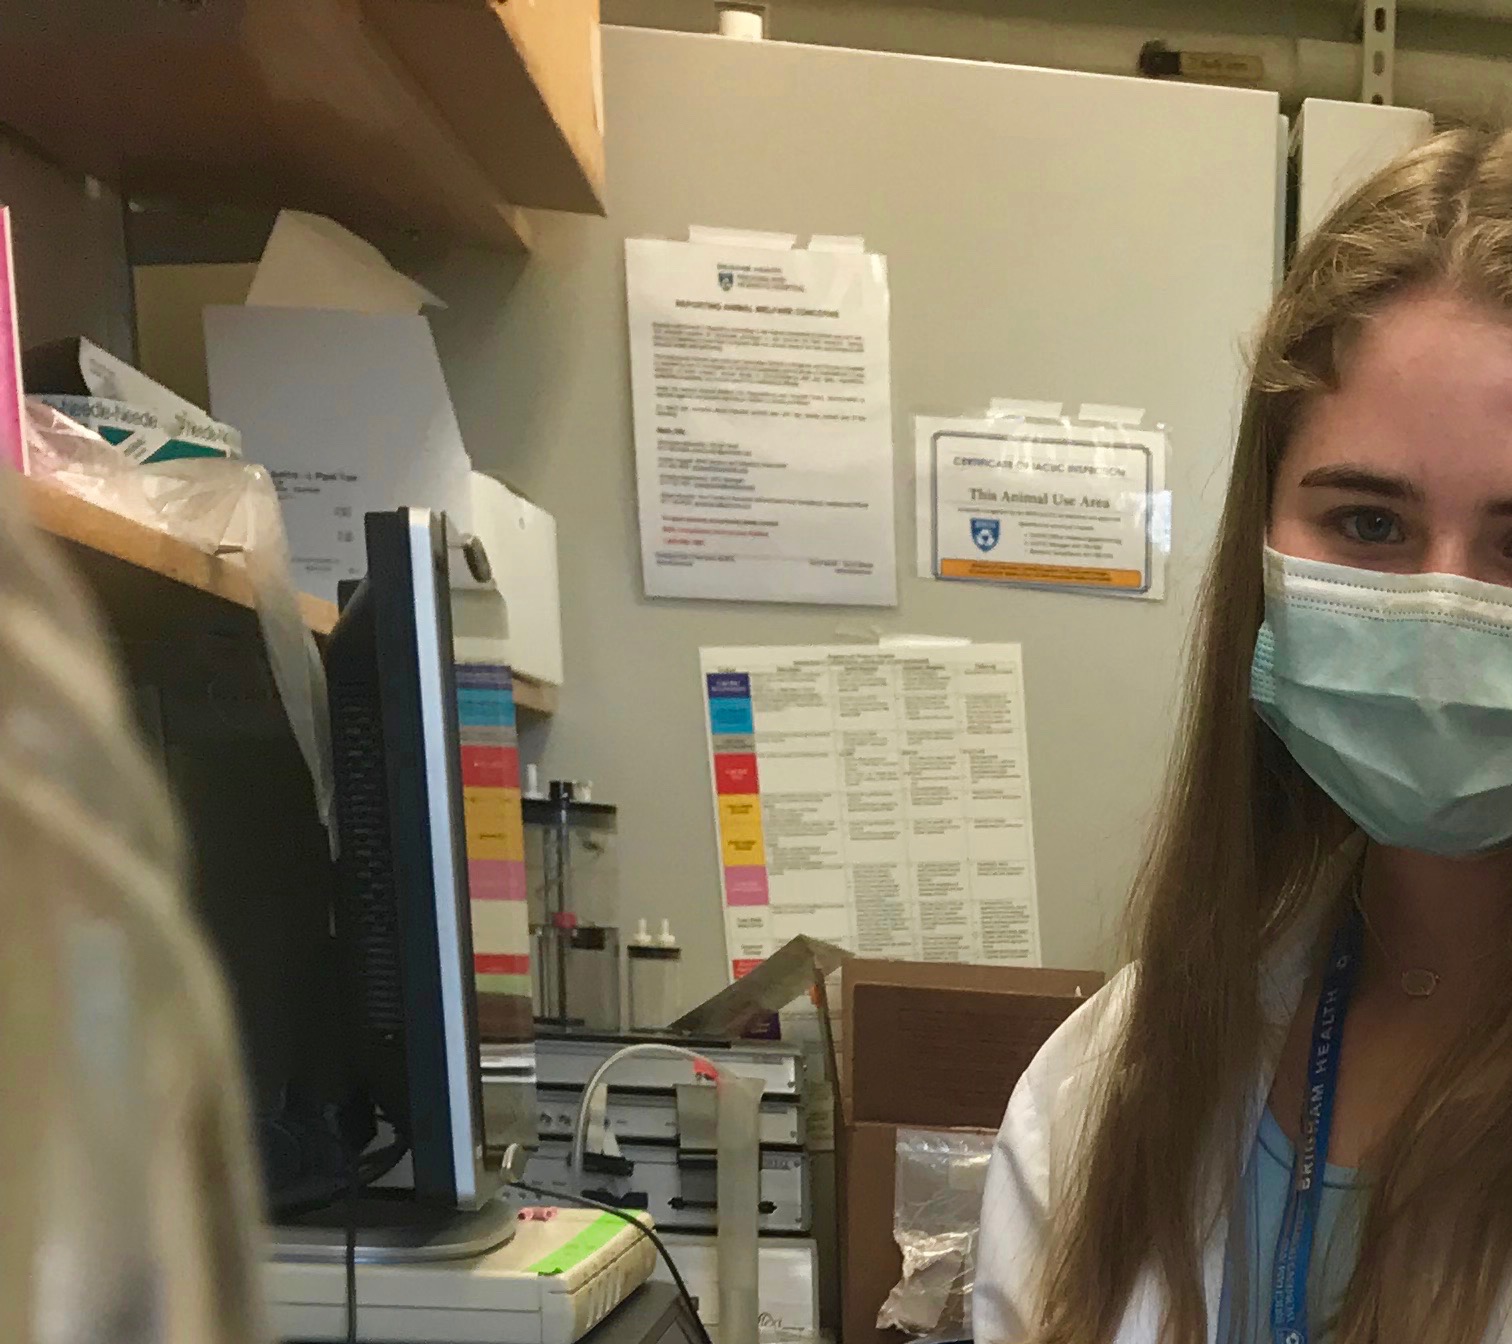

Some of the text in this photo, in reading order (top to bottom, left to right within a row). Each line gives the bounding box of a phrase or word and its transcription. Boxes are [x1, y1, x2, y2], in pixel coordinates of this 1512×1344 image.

[969, 488, 1110, 508] This Animal Use Area
[1315, 987, 1338, 1073] HEALTH
